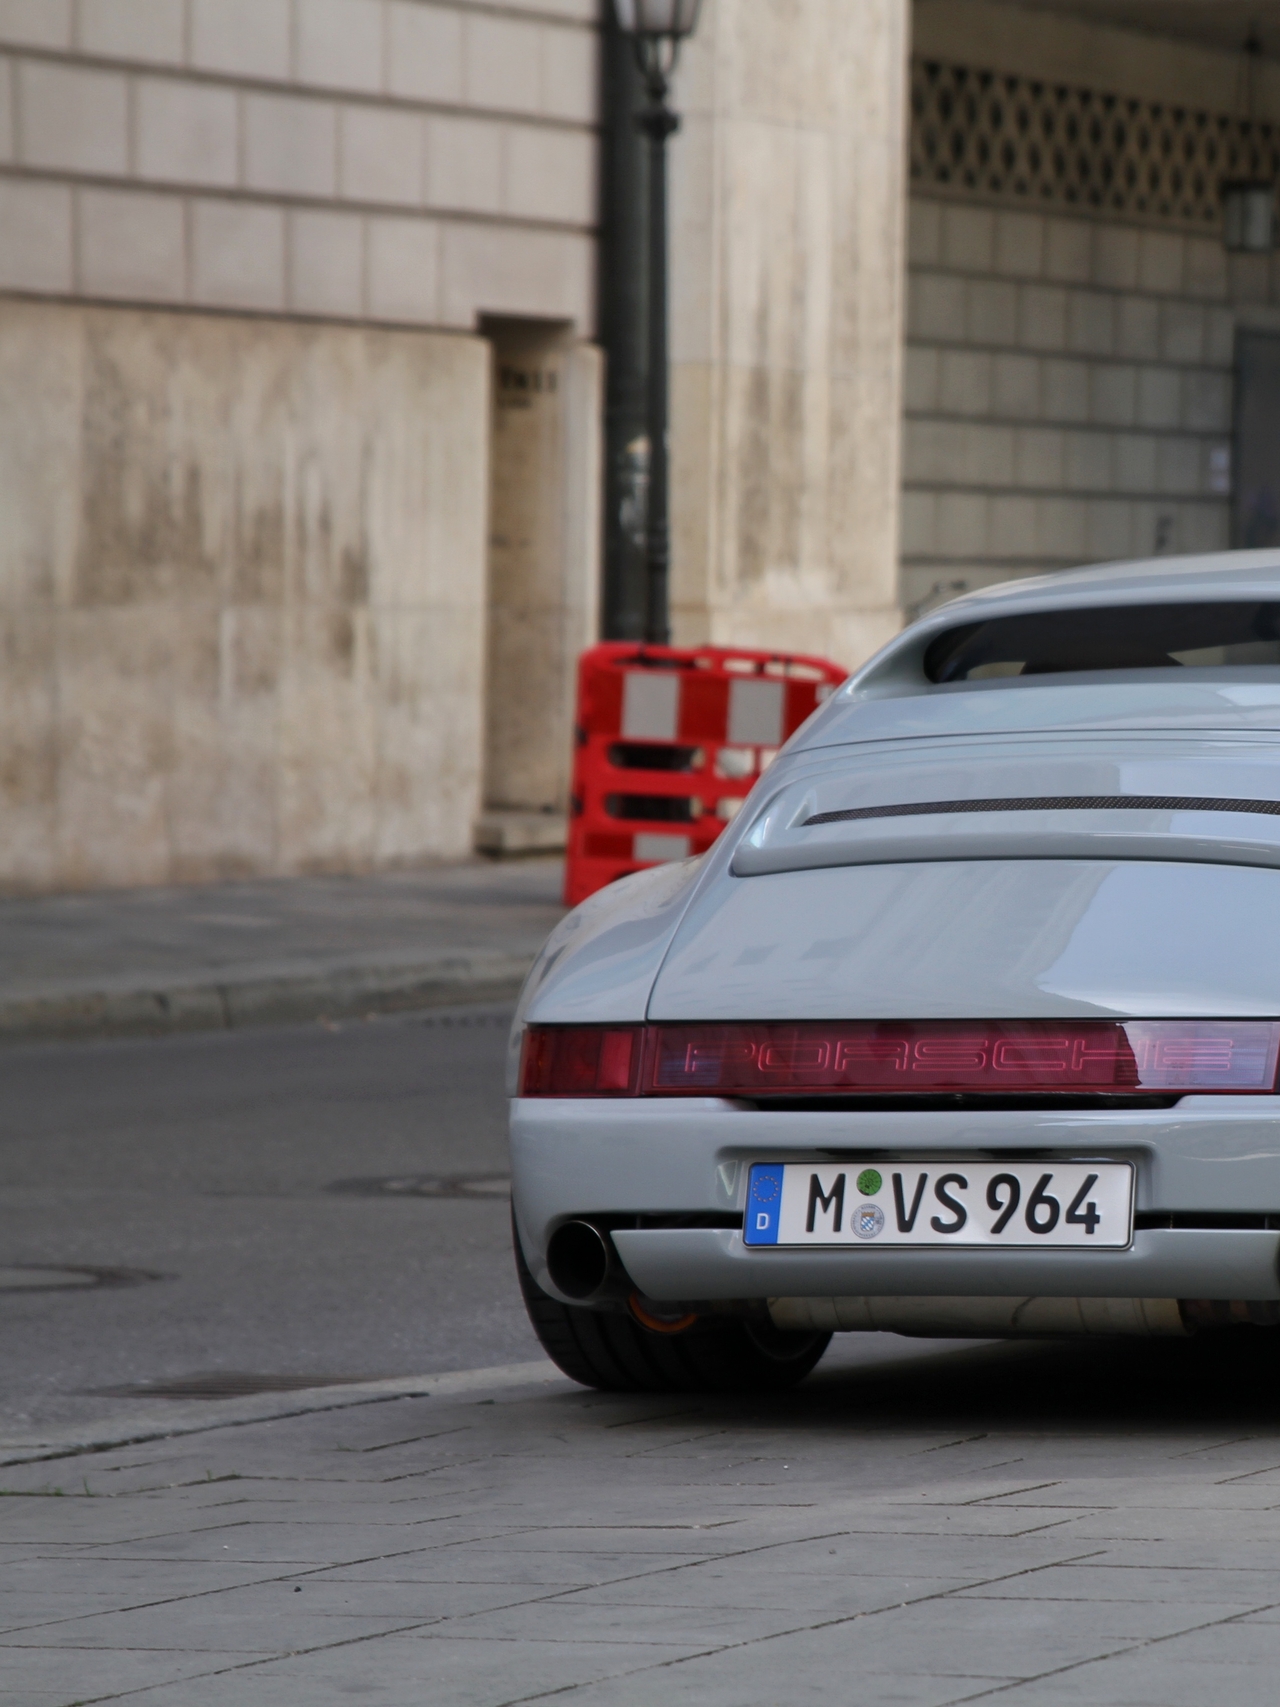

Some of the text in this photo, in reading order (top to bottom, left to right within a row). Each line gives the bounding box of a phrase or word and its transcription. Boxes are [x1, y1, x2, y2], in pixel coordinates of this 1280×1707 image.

[684, 1038, 1233, 1073] PORSCHE
[805, 1173, 846, 1233] M
[892, 1172, 968, 1234] VS
[986, 1172, 1101, 1234] 964
[756, 1213, 770, 1230] D
